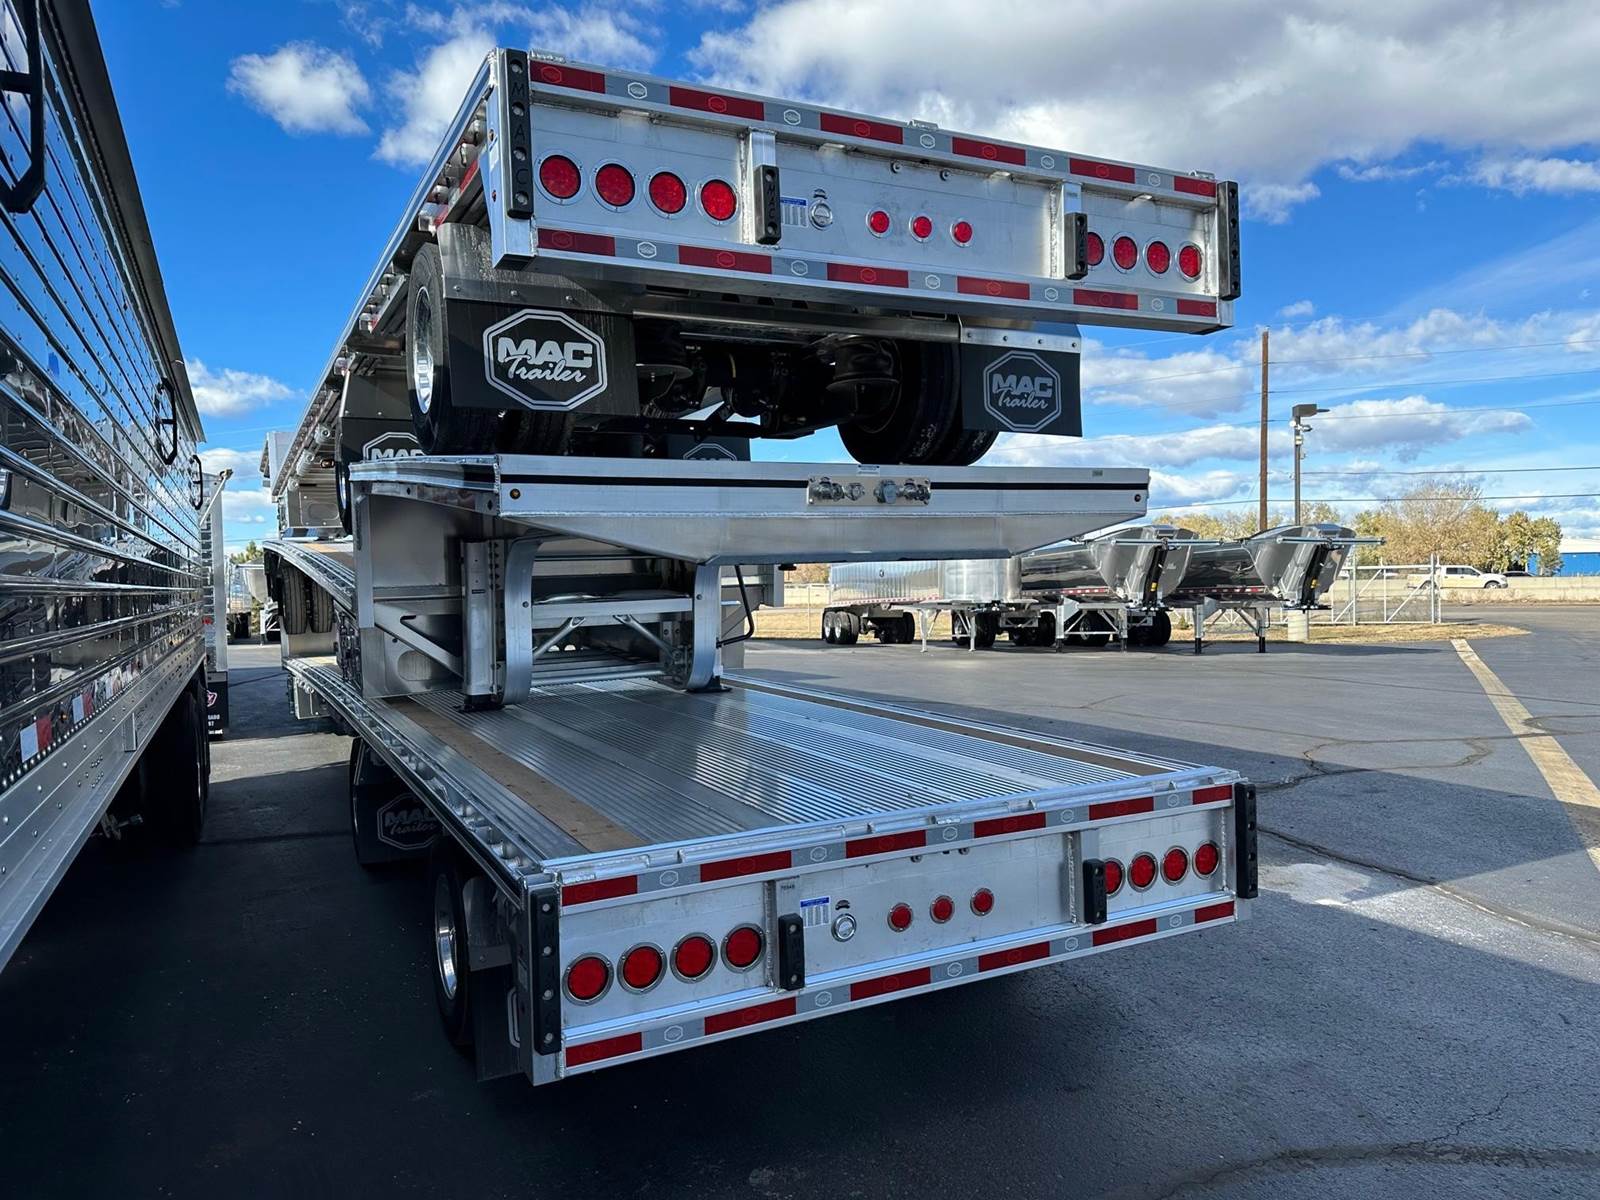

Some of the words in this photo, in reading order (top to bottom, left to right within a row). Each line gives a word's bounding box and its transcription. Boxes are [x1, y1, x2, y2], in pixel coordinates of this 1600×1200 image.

[498, 337, 593, 368] MAC
[504, 354, 587, 383] Trailer
[992, 373, 1053, 398] MAC
[998, 387, 1048, 409] Trailer
